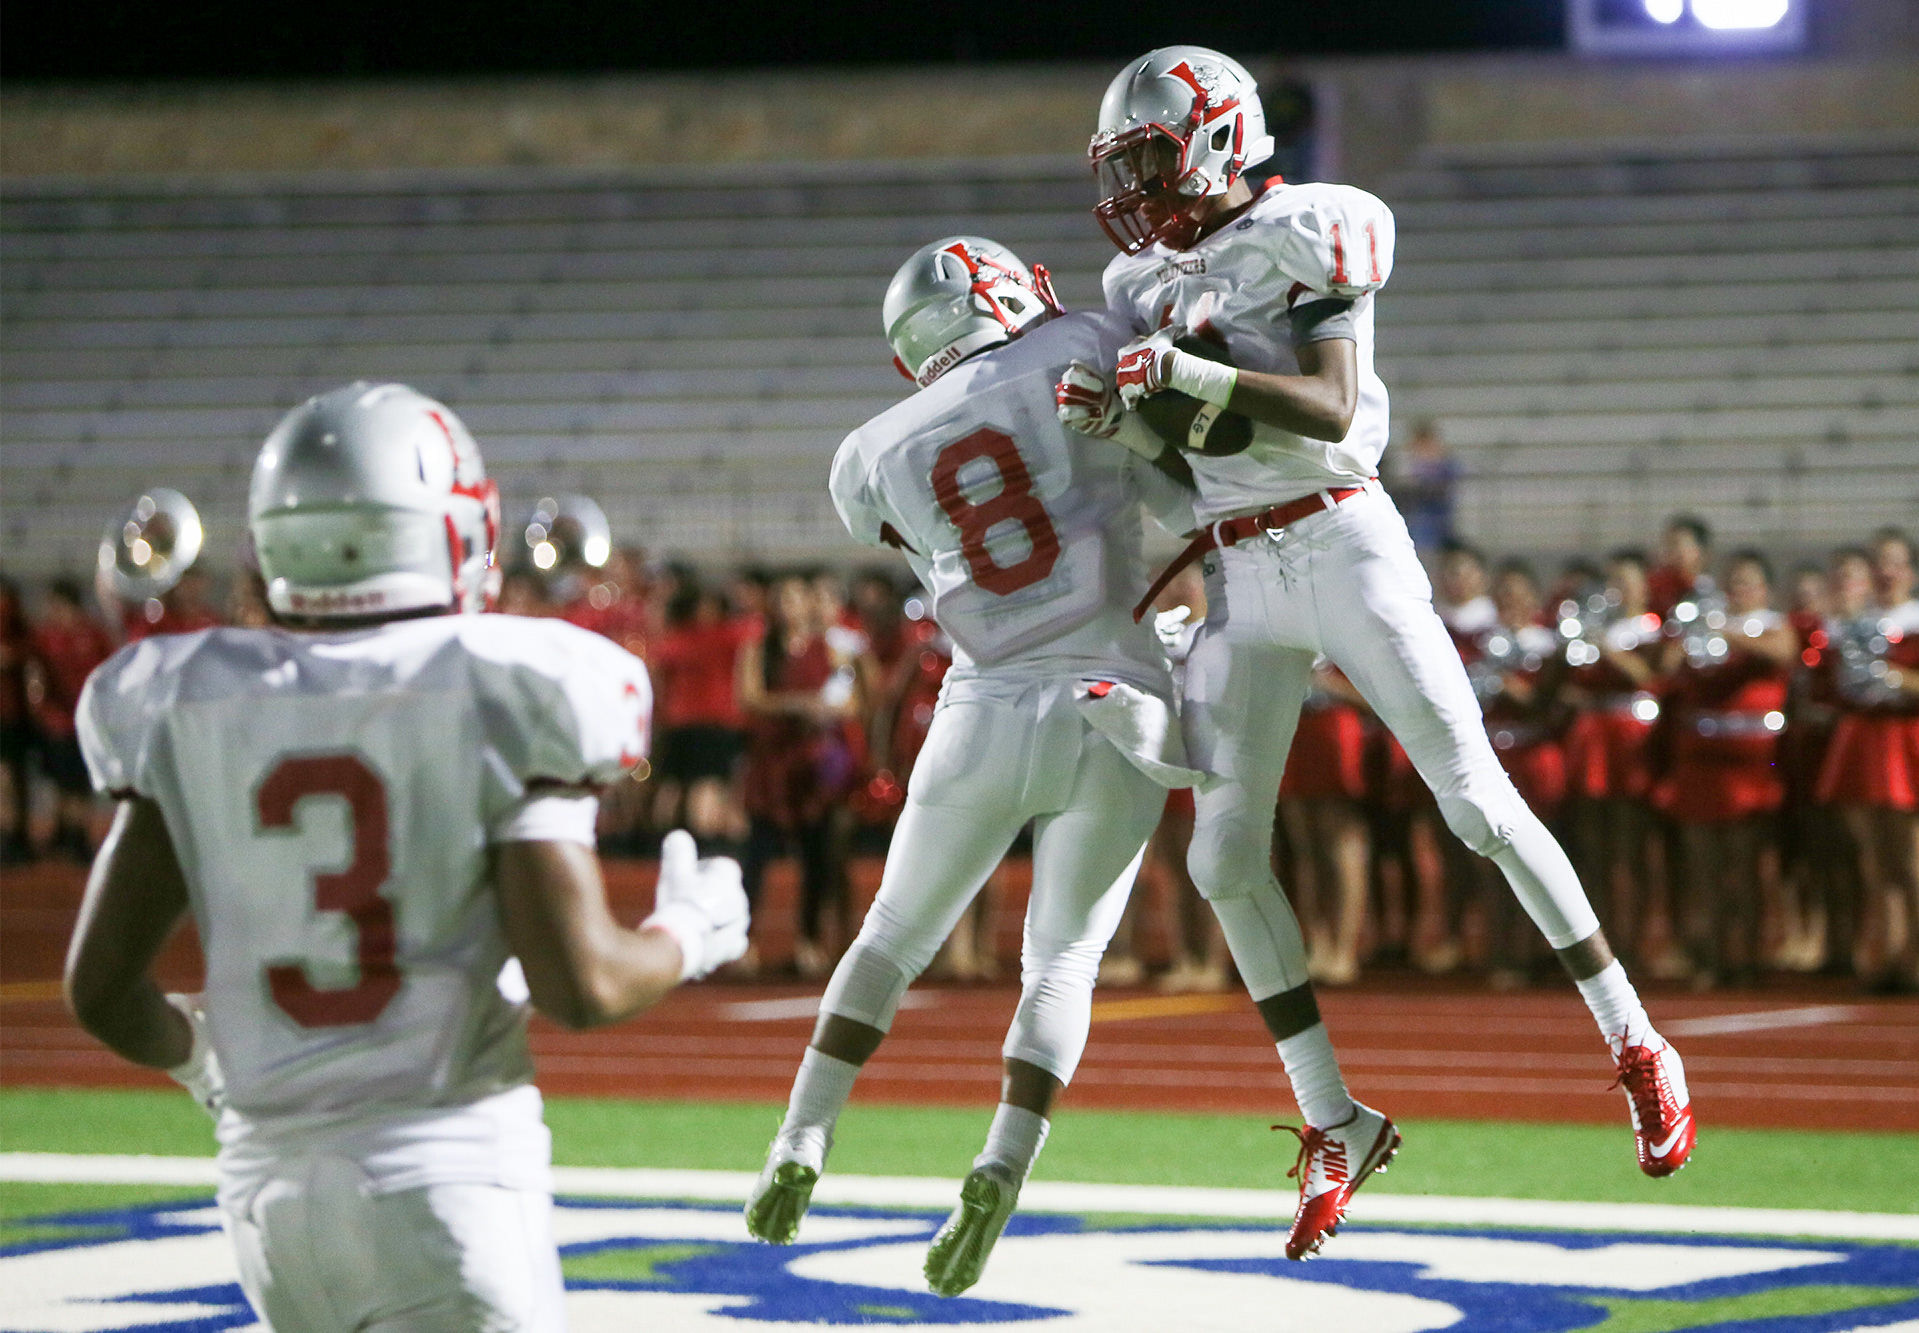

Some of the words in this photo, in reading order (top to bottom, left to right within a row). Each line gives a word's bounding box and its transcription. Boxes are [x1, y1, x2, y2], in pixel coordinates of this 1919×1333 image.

[1327, 220, 1382, 286] 11
[931, 424, 1062, 597] 8
[257, 753, 402, 1029] 3
[1322, 1139, 1349, 1185] NIKE
